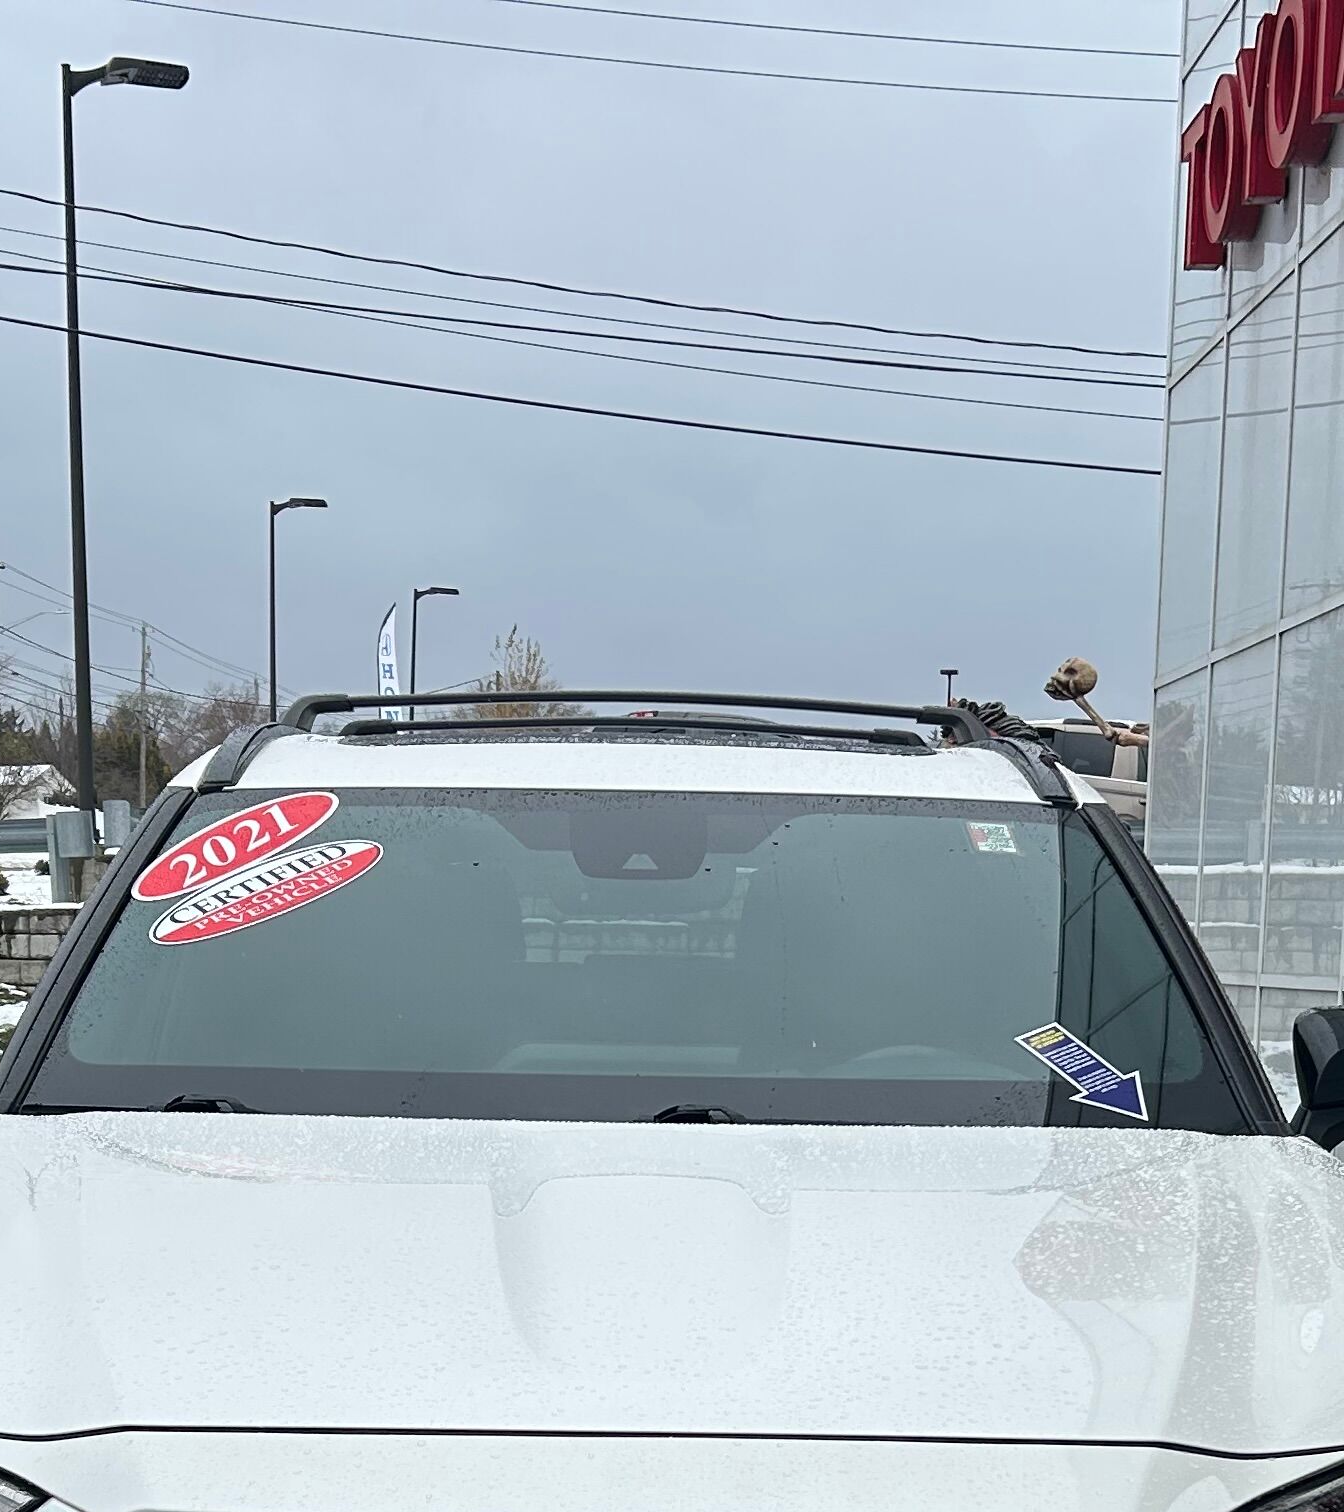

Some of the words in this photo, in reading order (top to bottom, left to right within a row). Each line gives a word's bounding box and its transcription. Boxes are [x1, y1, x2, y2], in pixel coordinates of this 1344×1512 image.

[169, 803, 300, 889] 2021
[169, 845, 347, 924] CERTIFIED
[194, 859, 353, 930] PRE-OWNED
[227, 873, 344, 923] VEHICLE
